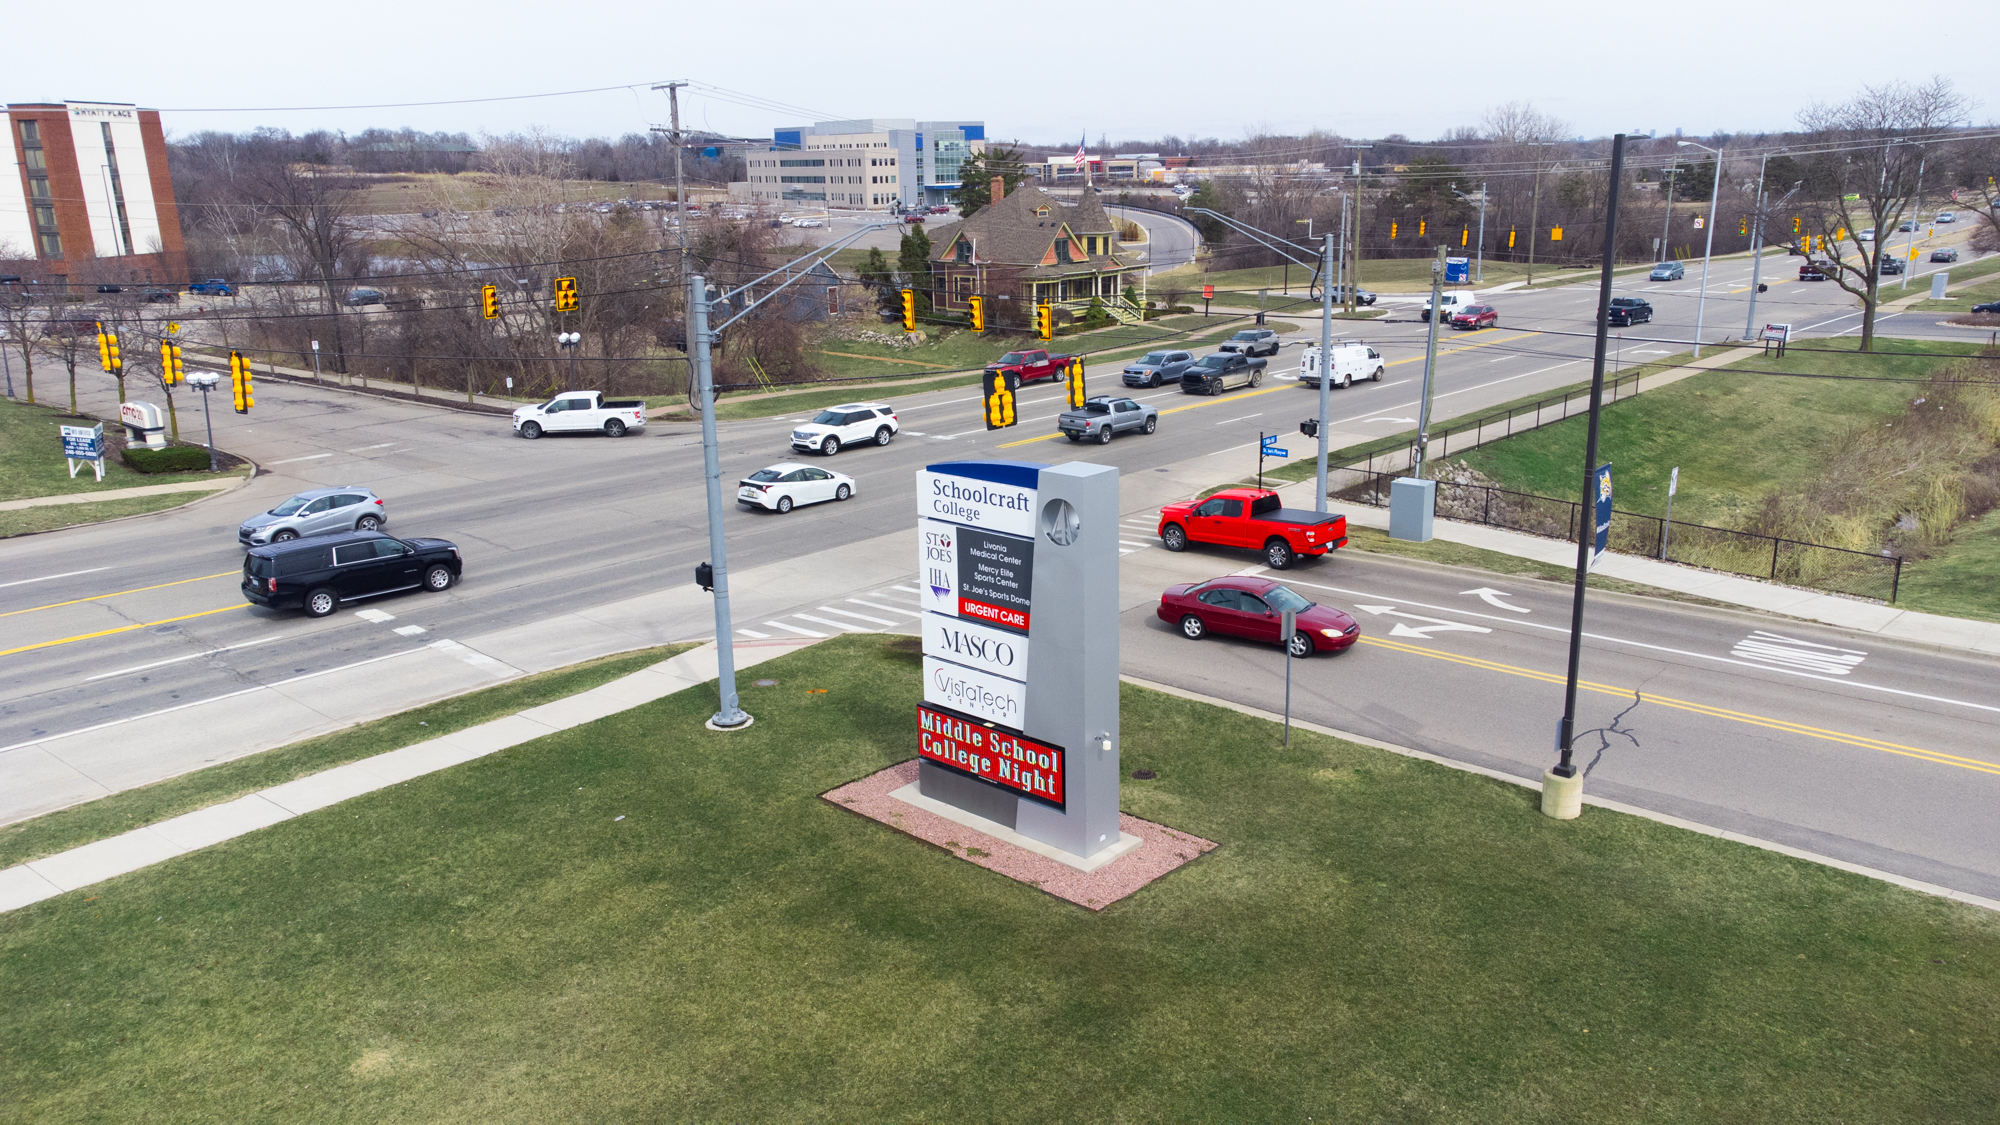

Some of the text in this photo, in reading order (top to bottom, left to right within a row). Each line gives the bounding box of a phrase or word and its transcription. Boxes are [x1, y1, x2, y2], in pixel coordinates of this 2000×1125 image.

[108, 110, 132, 118] PLACE
[933, 479, 1030, 512] Schoolcraft
[933, 499, 980, 521] College
[925, 532, 941, 546] ST.
[983, 541, 1007, 553] Livonia
[926, 546, 952, 563] JOE'S
[970, 547, 1022, 566] Medical Center
[929, 567, 951, 588] IHA
[974, 572, 1019, 589] Sports Center
[978, 563, 1014, 578] Mercy Elite
[962, 583, 1030, 606] St. Joe's Sports Dome
[964, 602, 1025, 626] URGENT CARE
[940, 627, 1014, 666] MASCO
[947, 695, 1007, 718] CENTER
[920, 709, 1058, 773] Middle School
[922, 732, 1056, 795] College Night
